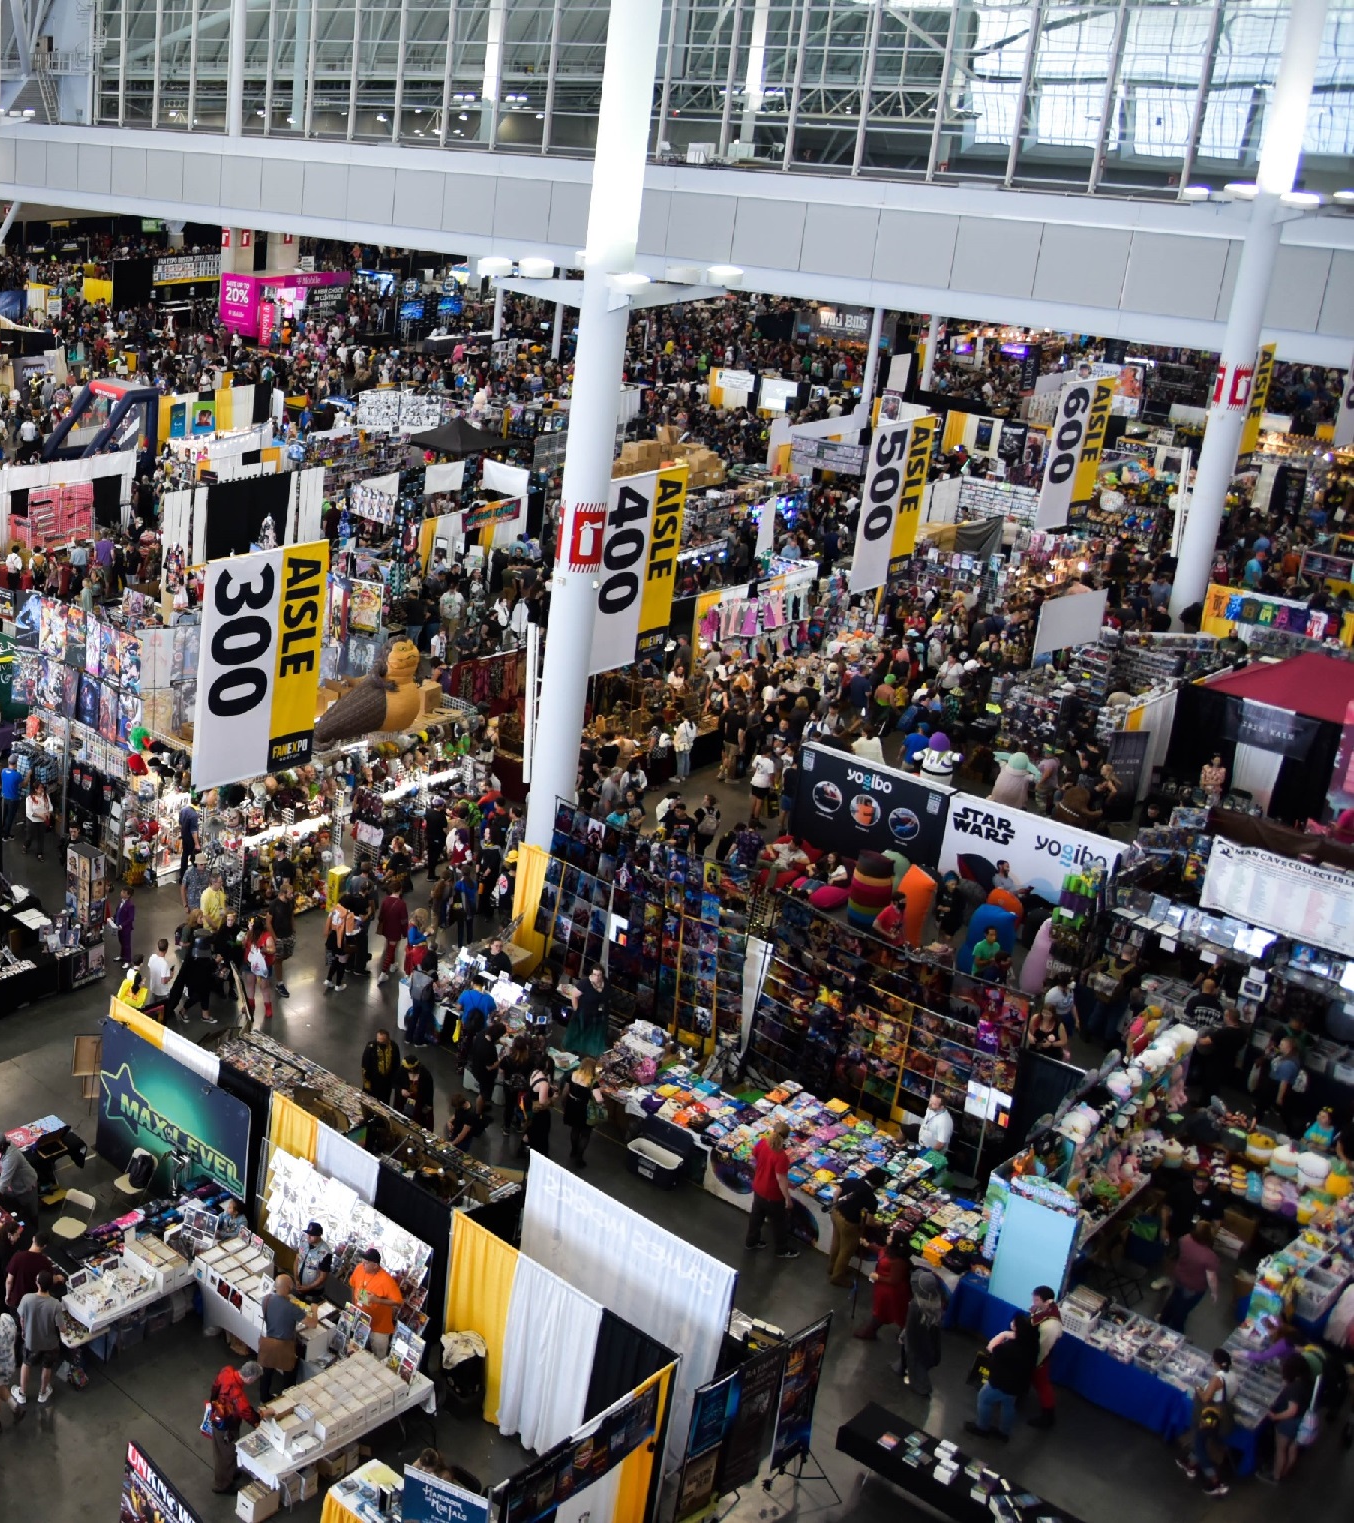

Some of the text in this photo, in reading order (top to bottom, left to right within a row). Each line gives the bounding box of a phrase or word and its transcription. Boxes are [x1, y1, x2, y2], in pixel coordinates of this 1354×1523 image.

[224, 287, 248, 304] 20%
[1023, 356, 1035, 389] FUDGE
[1246, 349, 1274, 420] AISLE
[1048, 386, 1090, 484] 600
[1080, 384, 1112, 464] AISLE
[863, 428, 908, 542] 500
[898, 426, 931, 515] AISLE
[598, 485, 650, 615] 400
[647, 478, 686, 582] AISLE
[207, 562, 275, 718] 300
[278, 556, 322, 679] AISLE
[846, 767, 893, 793] yogibo
[953, 806, 1015, 835] STAR
[953, 817, 1014, 845] WARS
[1235, 847, 1259, 858] MAN
[119, 1093, 169, 1140] MAX
